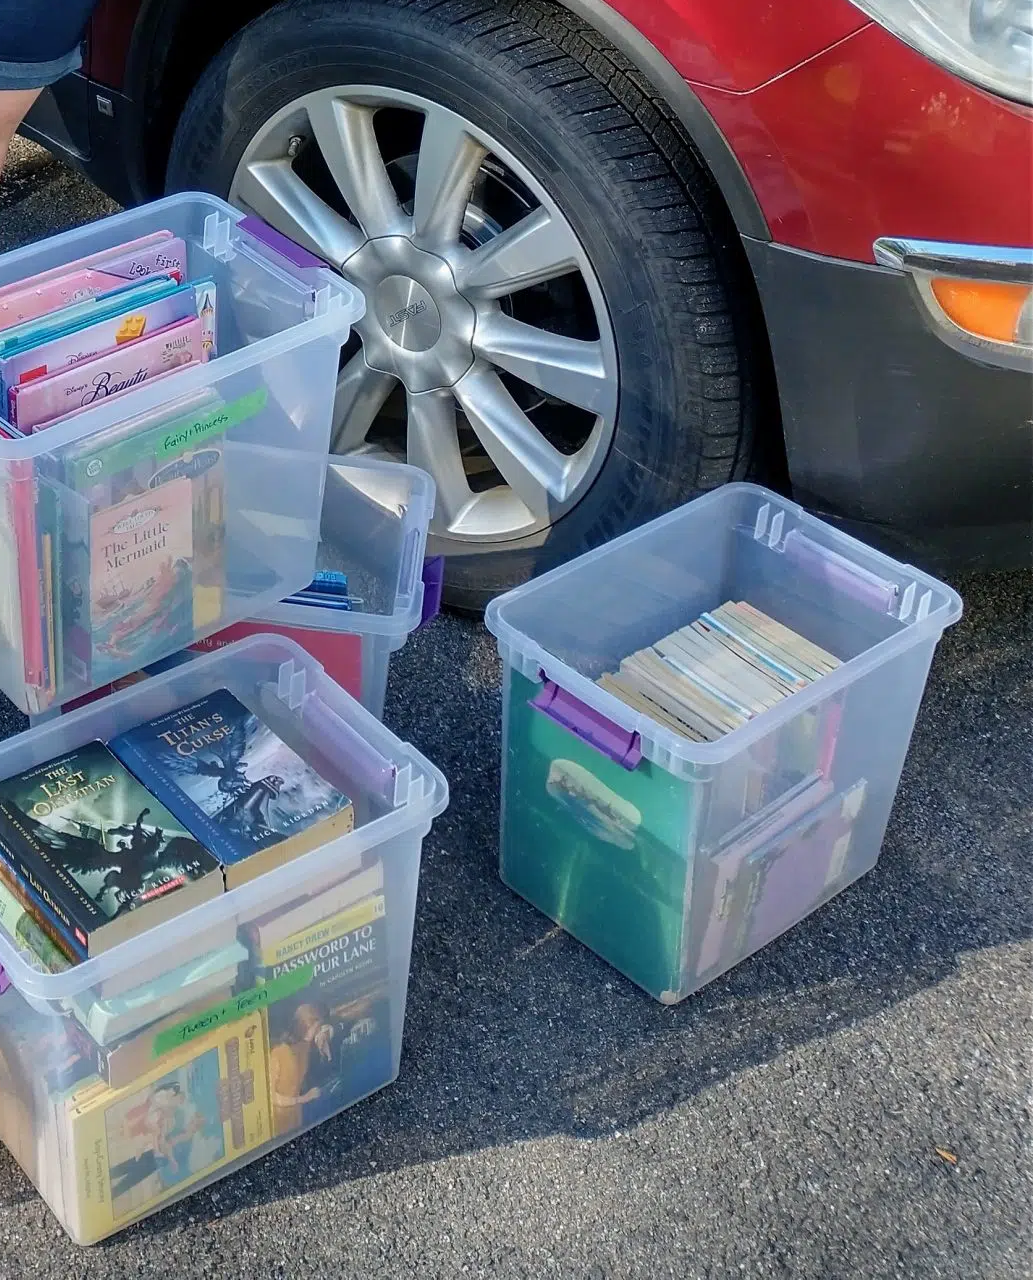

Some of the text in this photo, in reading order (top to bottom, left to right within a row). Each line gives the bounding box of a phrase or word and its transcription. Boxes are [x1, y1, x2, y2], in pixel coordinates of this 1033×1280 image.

[389, 300, 427, 327] FAST
[80, 367, 148, 407] Beauty
[101, 522, 170, 558] The Little
[106, 535, 166, 572] Mermaid
[156, 712, 224, 747] TITAN'S
[174, 713, 196, 726] THE
[176, 724, 234, 757] CURSE
[40, 770, 87, 798] LAST
[44, 766, 69, 781] THE
[253, 801, 330, 842] RICK RIORDAN
[272, 925, 373, 979] PASSWORD TO
[343, 938, 377, 963] LANE
[236, 990, 268, 1011] Teen
